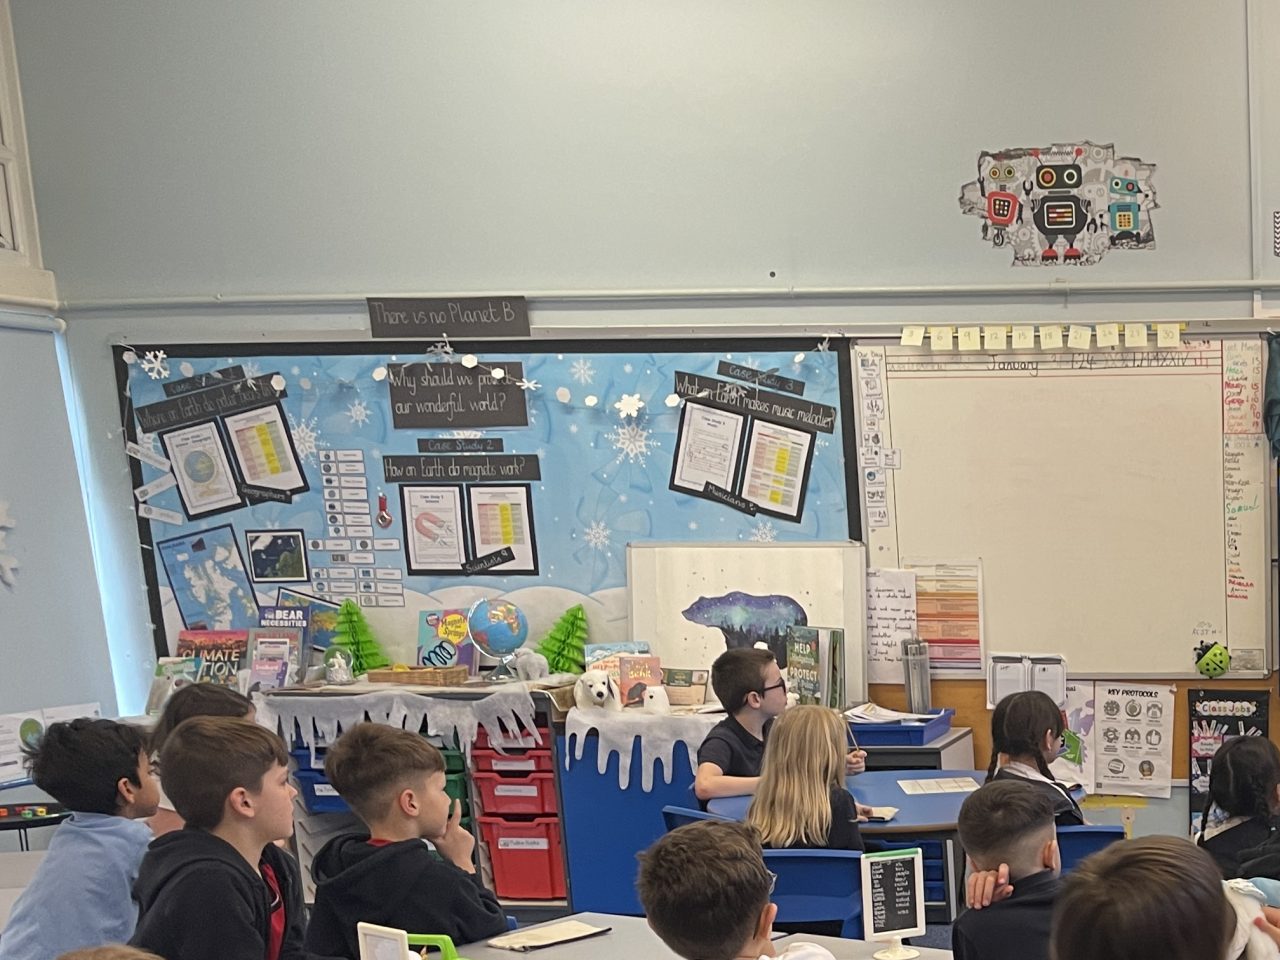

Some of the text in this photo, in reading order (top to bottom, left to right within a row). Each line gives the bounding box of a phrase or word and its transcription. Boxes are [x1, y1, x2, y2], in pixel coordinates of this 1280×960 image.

[372, 302, 515, 324] There is no Planet B
[729, 365, 752, 379] Case
[987, 354, 1038, 377] January
[389, 368, 416, 395] Why
[421, 367, 454, 387] should
[457, 375, 473, 385] we
[676, 374, 699, 396] What
[396, 393, 506, 421] our wonderful world?
[428, 439, 494, 450] Case Study 2
[384, 459, 403, 476] How
[406, 466, 416, 476] on
[421, 458, 445, 477] Earth
[449, 460, 460, 476] do
[275, 610, 303, 620] BEAR
[794, 642, 811, 654] HELP
[790, 667, 817, 681] PROTECT
[1122, 690, 1159, 698] PROTOCOLS
[1202, 704, 1251, 712] Class Jobs
